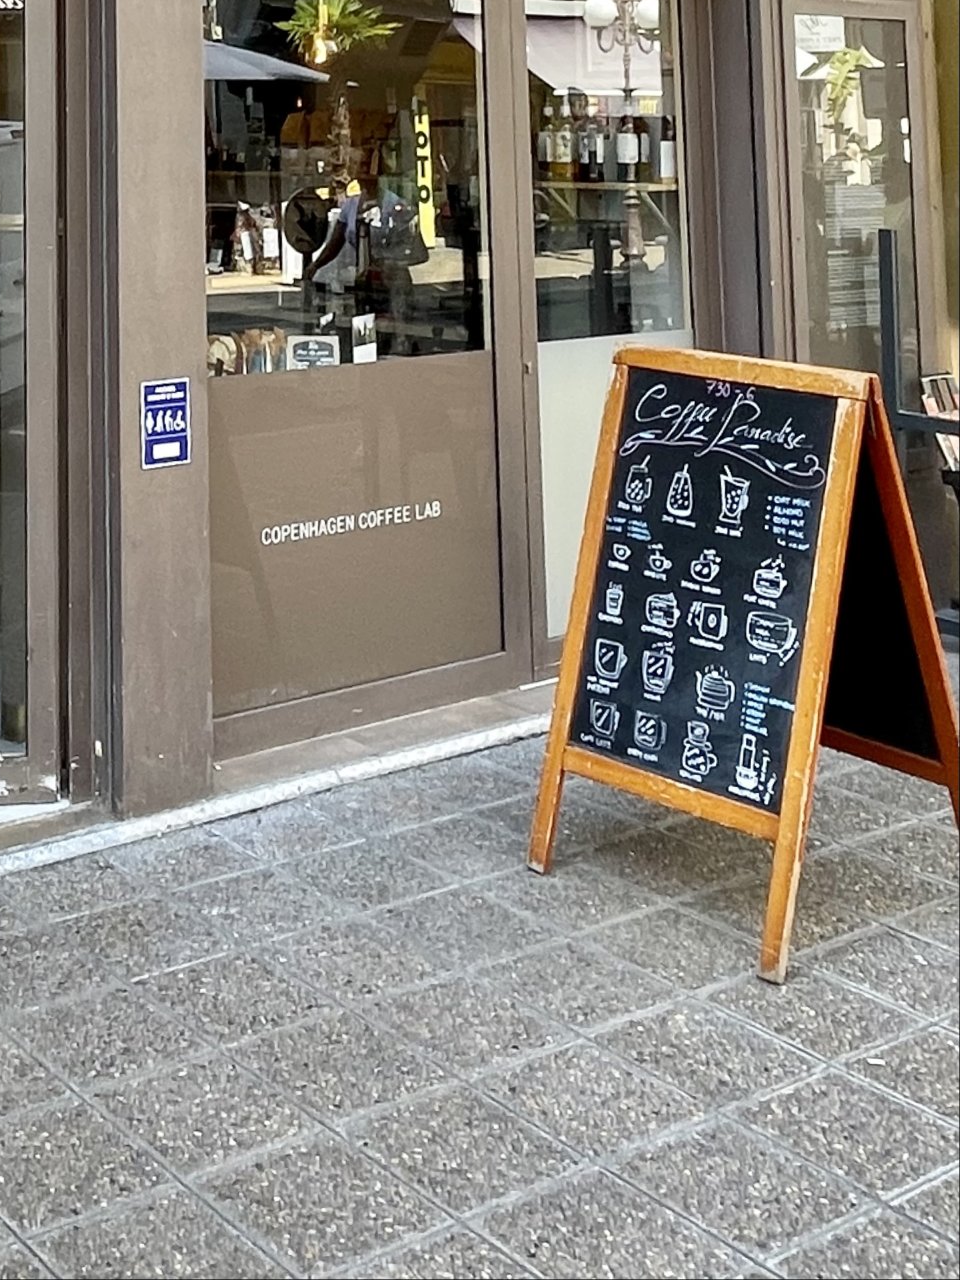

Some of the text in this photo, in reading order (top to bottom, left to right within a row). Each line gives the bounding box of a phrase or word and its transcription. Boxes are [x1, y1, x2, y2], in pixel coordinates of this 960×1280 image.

[261, 500, 441, 545] COPENHAGEN COFFEE LAB
